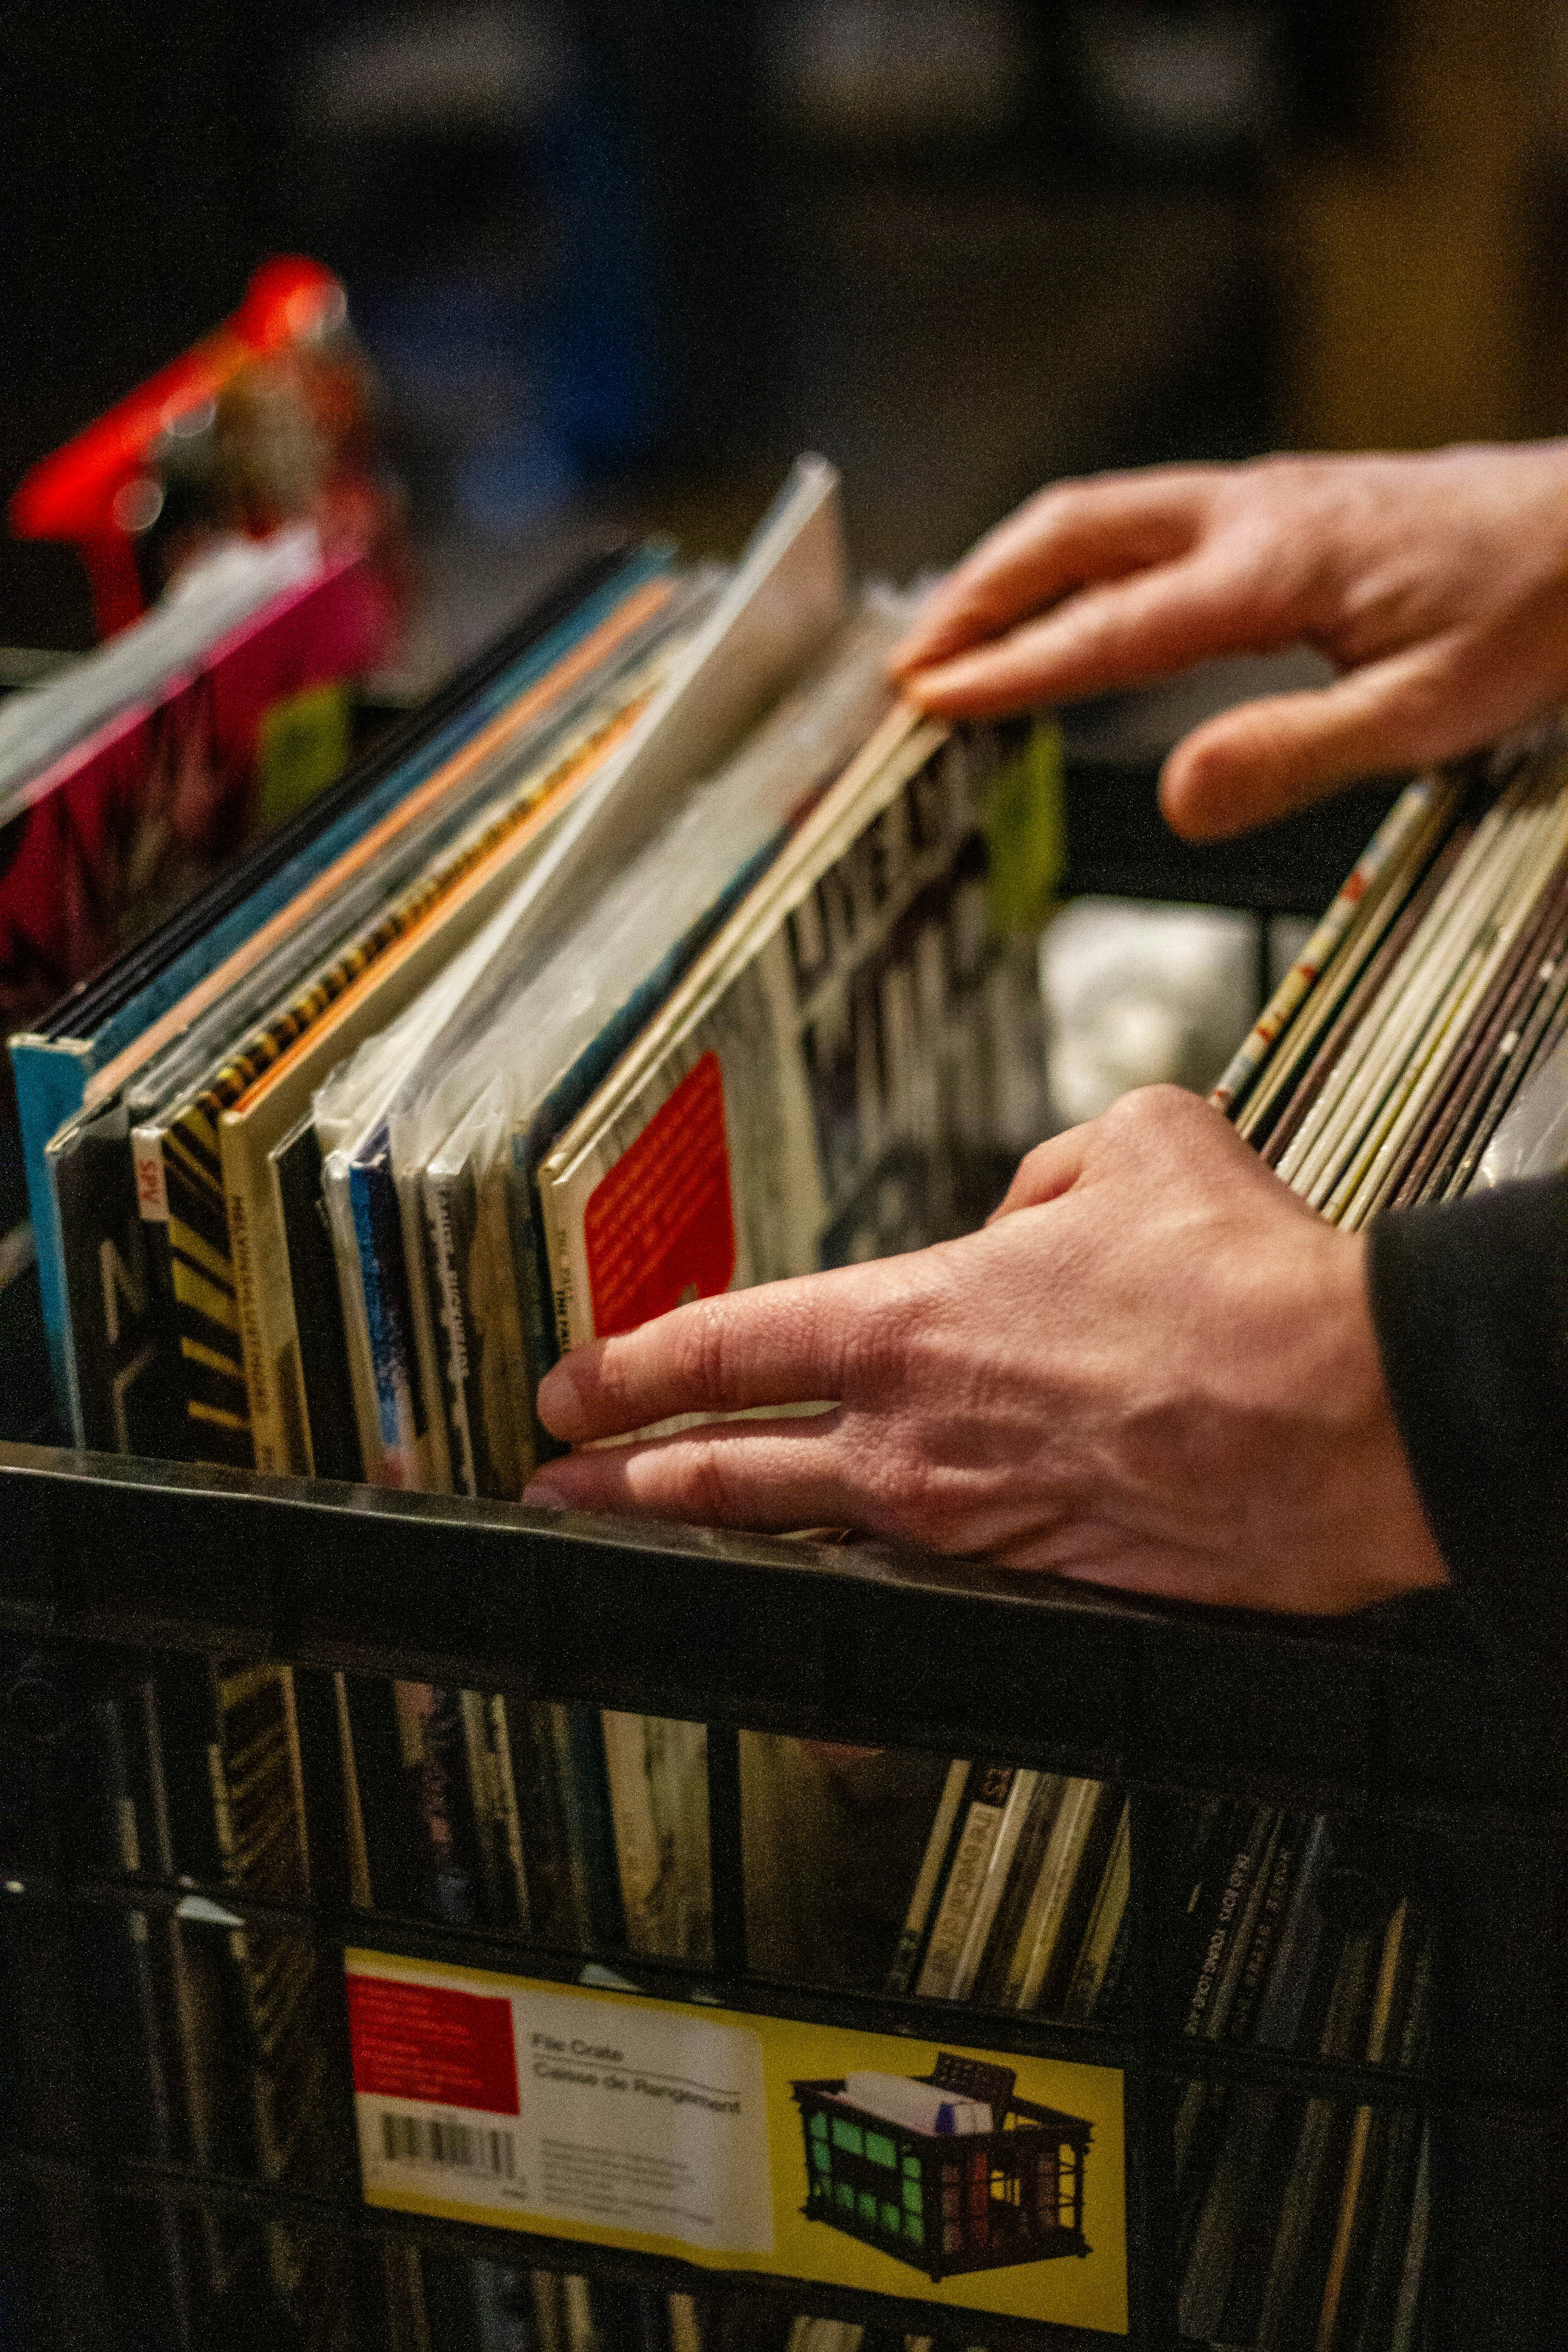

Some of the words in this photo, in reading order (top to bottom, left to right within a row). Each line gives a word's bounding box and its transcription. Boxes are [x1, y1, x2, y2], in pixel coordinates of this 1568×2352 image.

[1230, 1853, 1251, 1887] DEAD
[1218, 1891, 1239, 1921] BOYS
[1203, 1928, 1227, 1973] YOUNG
[1191, 1976, 1210, 2009] LOUD
[531, 2033, 566, 2053] File
[570, 2039, 623, 2062] Crate
[603, 2074, 628, 2092] de
